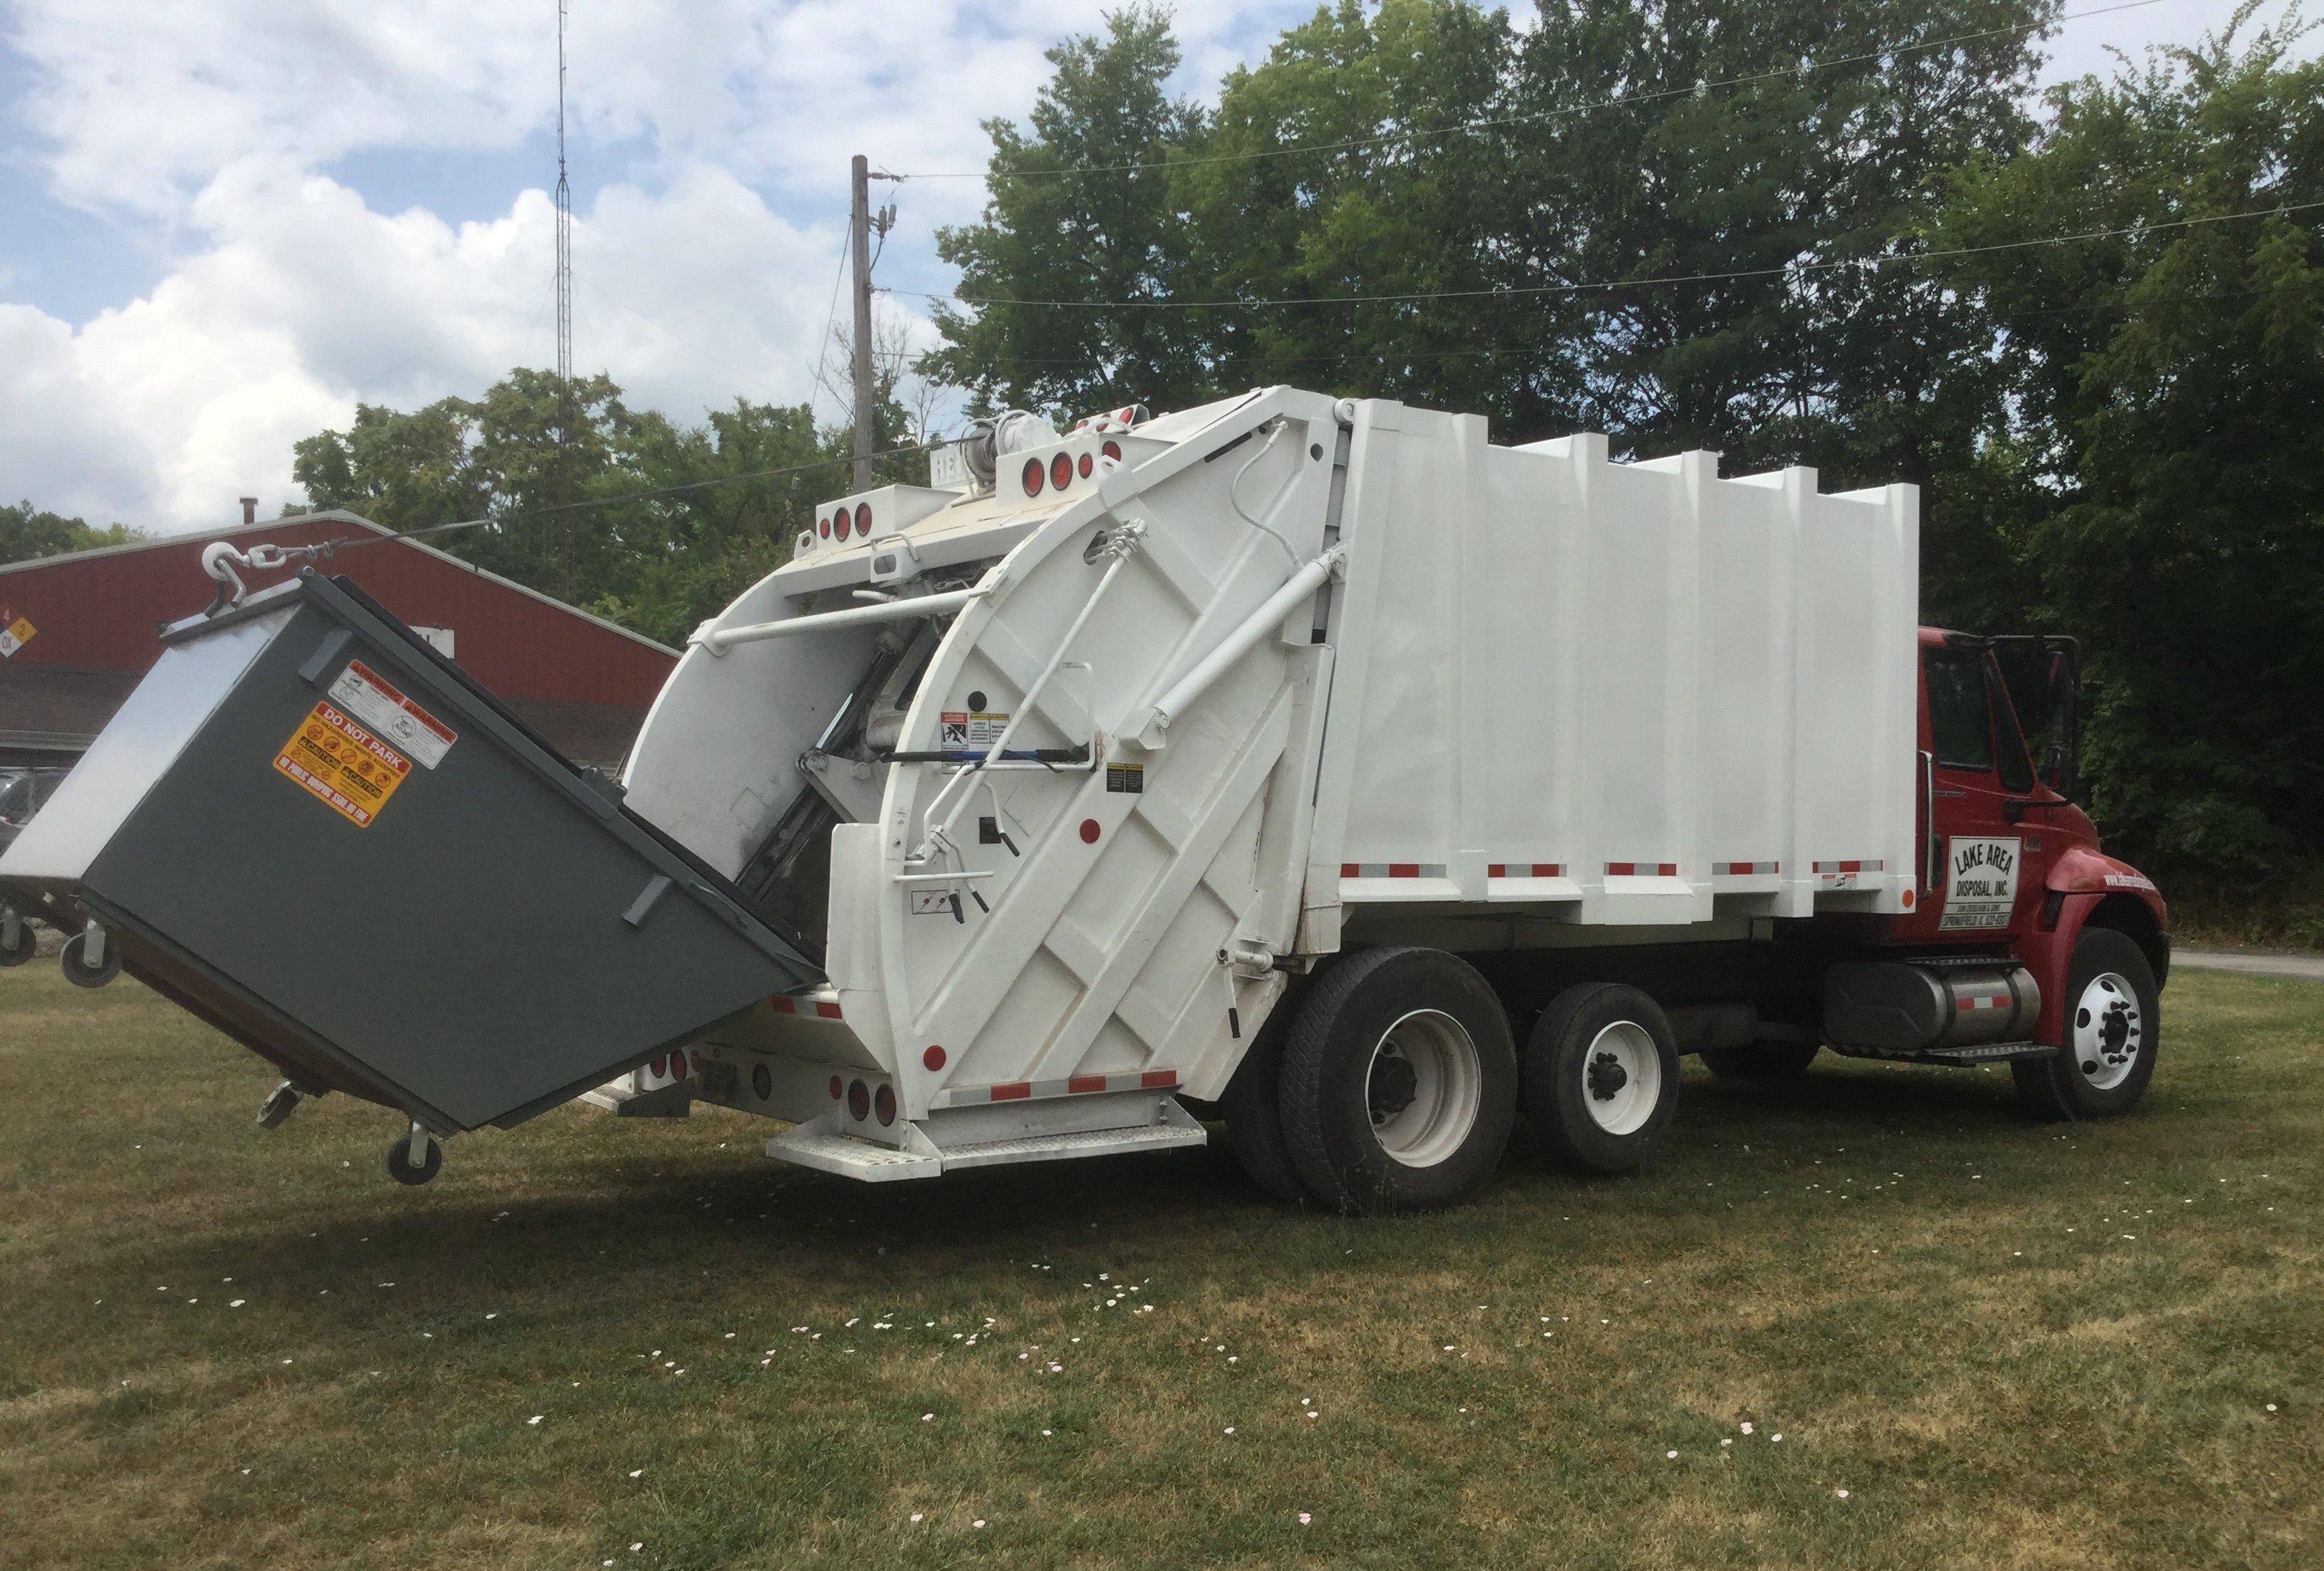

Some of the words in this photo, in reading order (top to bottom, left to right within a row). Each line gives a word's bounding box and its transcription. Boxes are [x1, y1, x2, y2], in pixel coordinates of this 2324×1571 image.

[4, 609, 10, 622] 4
[20, 624, 26, 637] 2
[2, 636, 11, 649] OX
[324, 708, 343, 725] DO
[344, 723, 370, 744] NOT
[369, 741, 402, 768] PARK
[307, 743, 340, 768] CAUTION
[349, 773, 382, 798] CAUTION
[1955, 843, 1983, 876] LAKE
[1986, 843, 2013, 876] AREA
[1995, 880, 2008, 896] INC.
